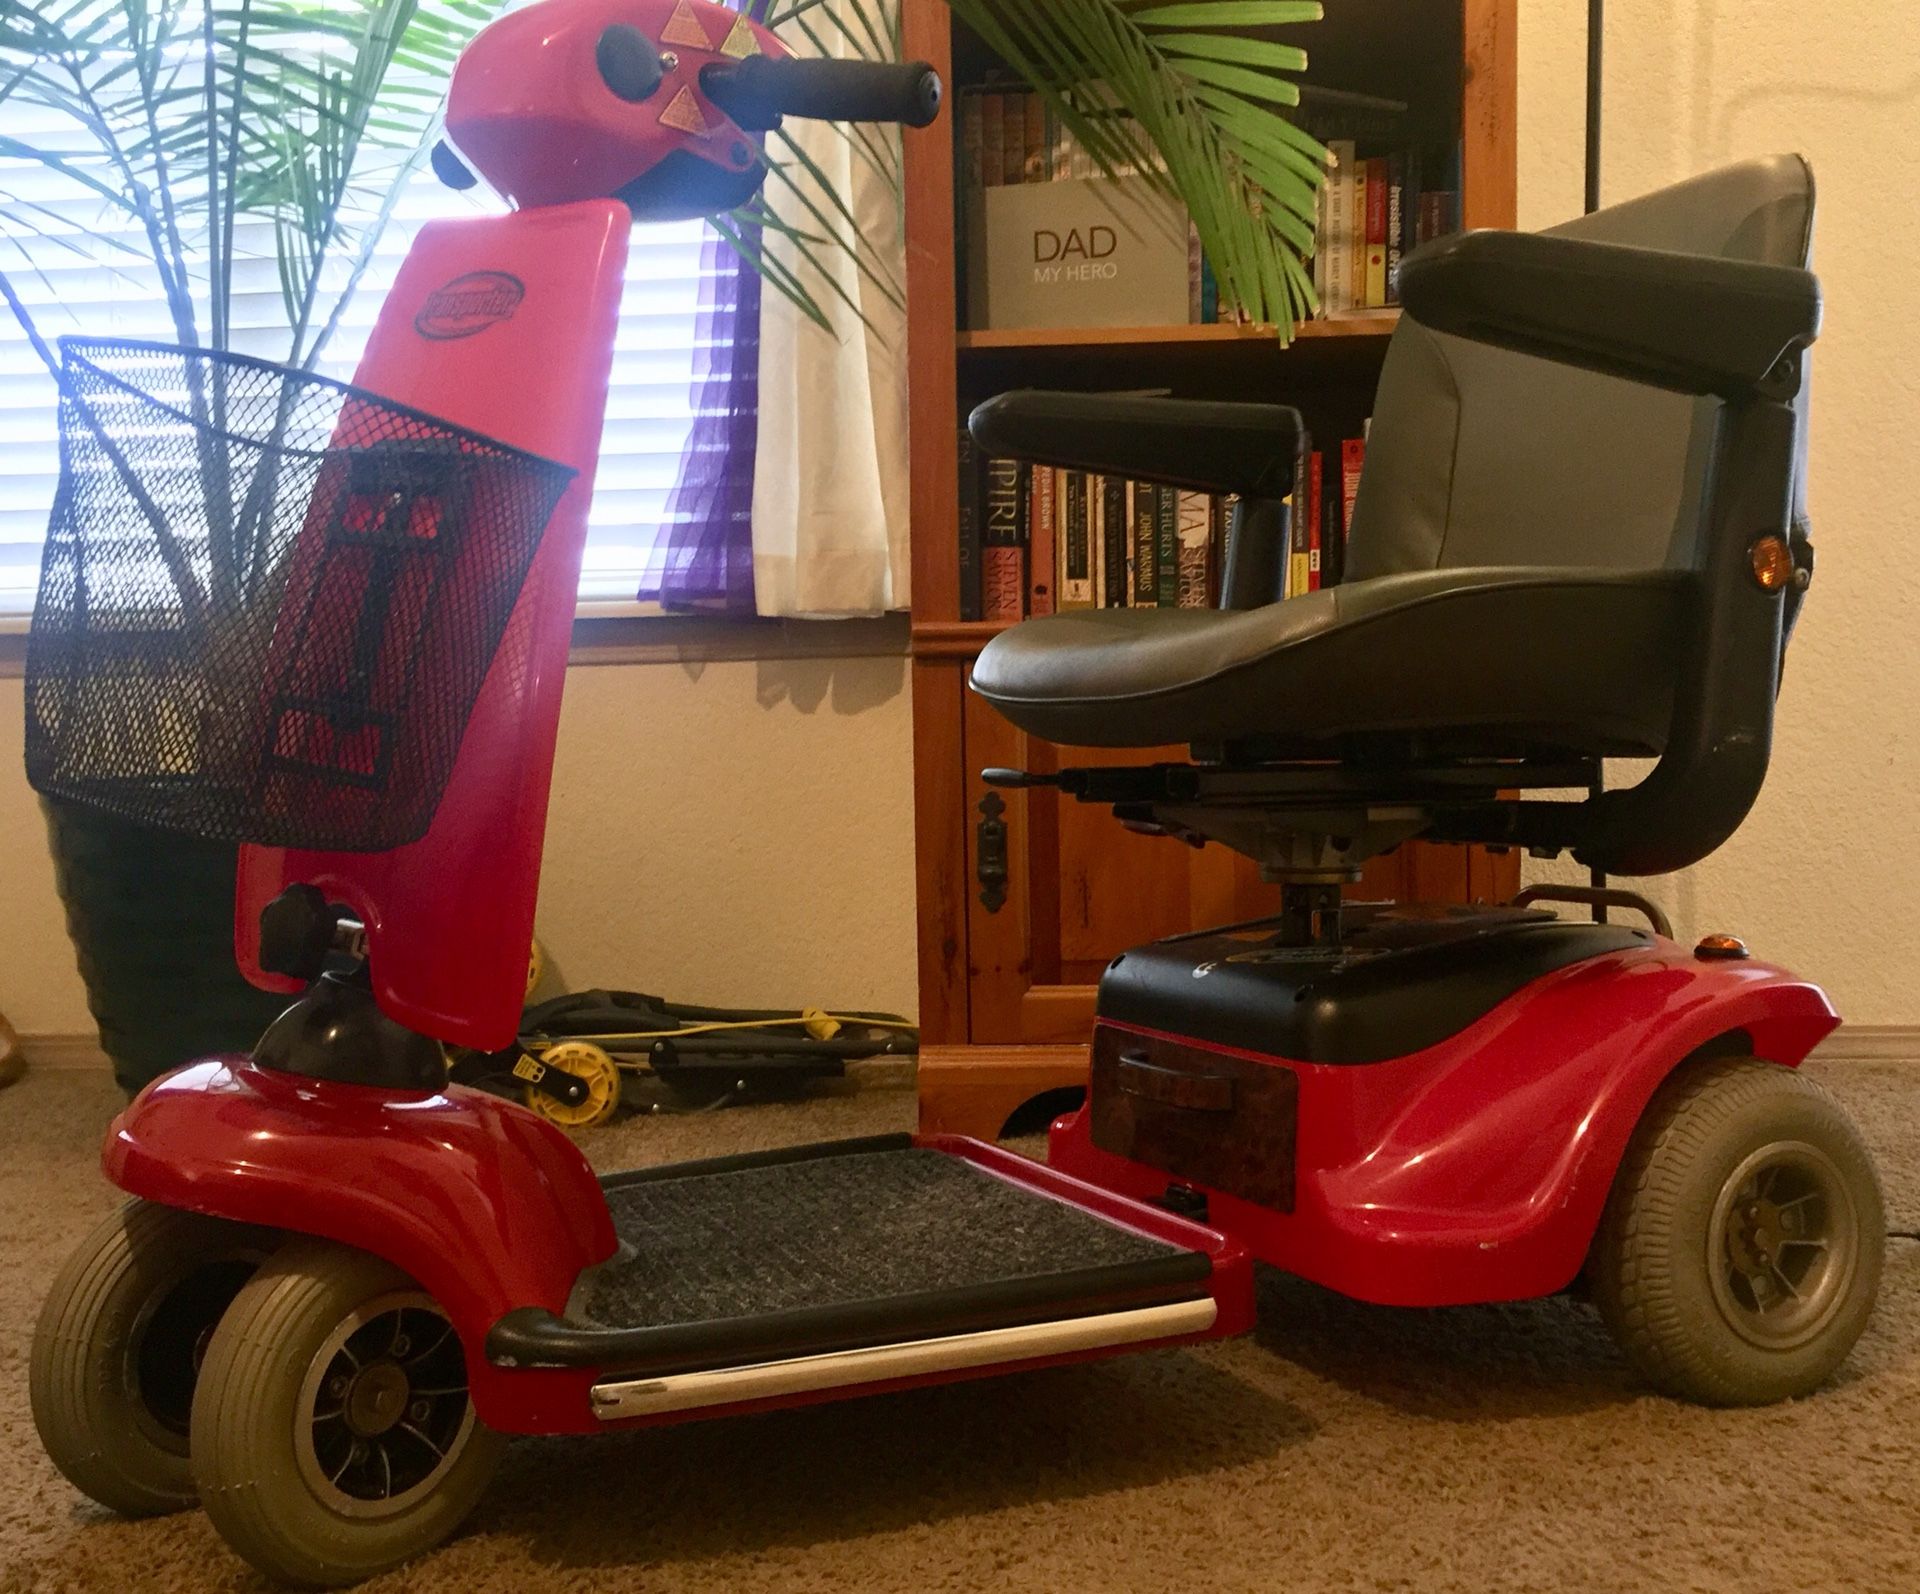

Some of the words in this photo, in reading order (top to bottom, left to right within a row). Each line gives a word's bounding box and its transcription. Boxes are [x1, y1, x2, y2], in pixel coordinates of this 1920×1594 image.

[1034, 225, 1118, 263] DAD
[1034, 267, 1062, 283] MY
[1066, 262, 1118, 281] HERO
[1041, 466, 1052, 495] PEDIA
[1139, 512, 1153, 541] JOHN
[1179, 491, 1206, 534] MA
[1161, 512, 1173, 557] HURTS
